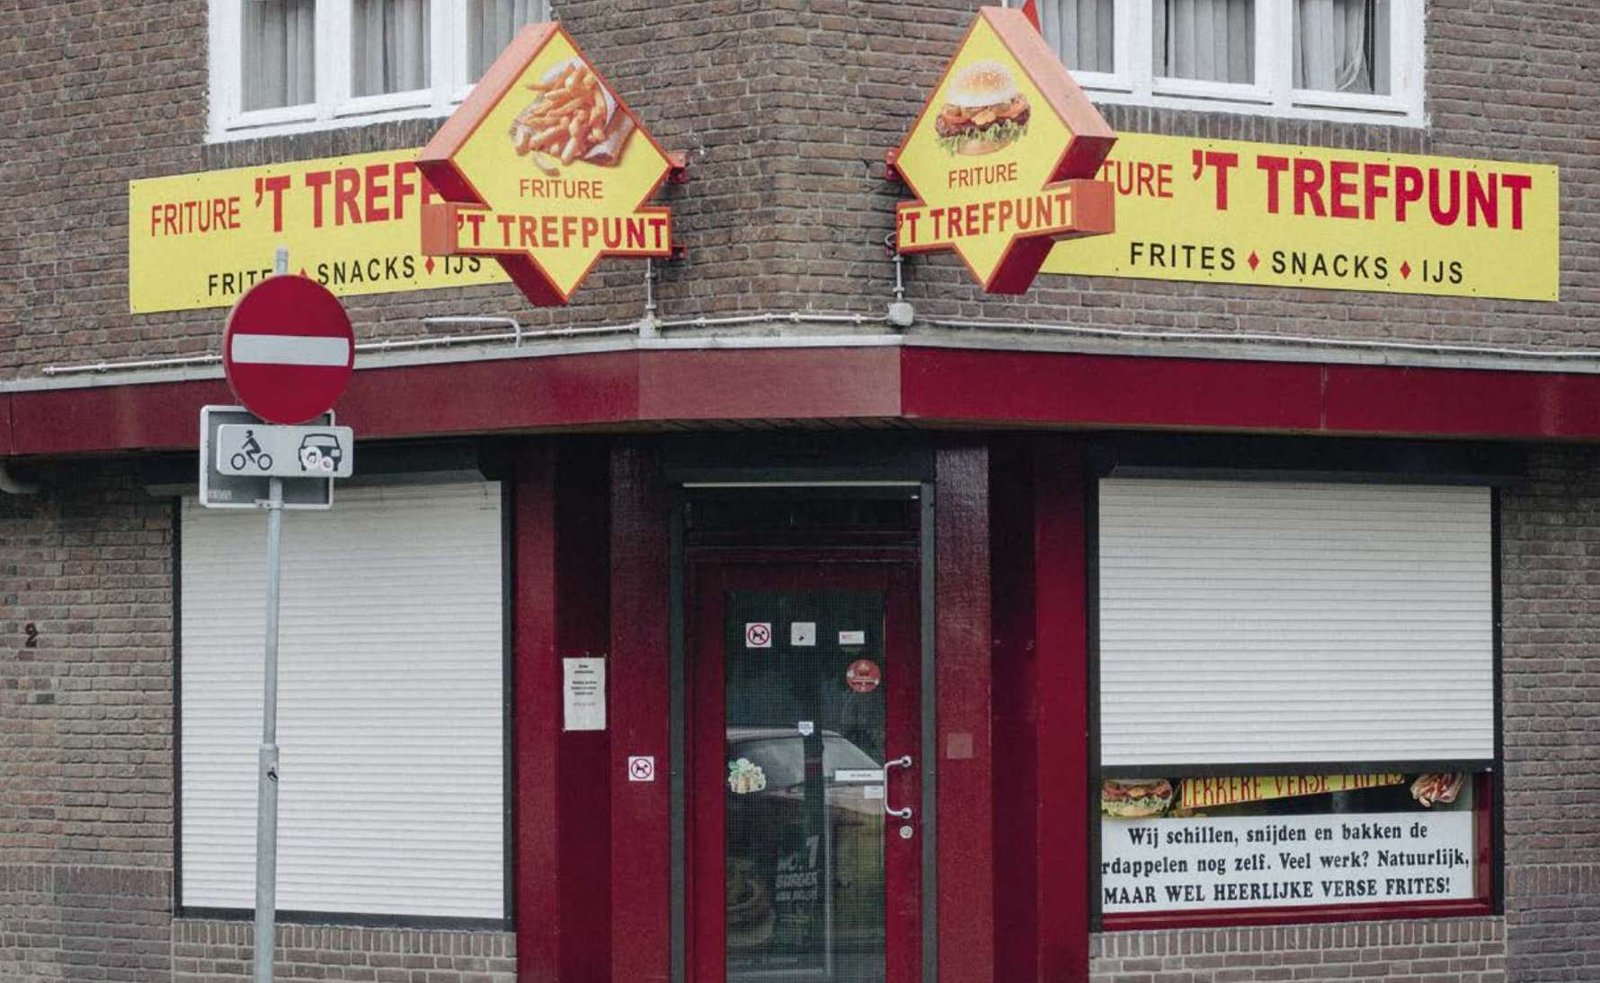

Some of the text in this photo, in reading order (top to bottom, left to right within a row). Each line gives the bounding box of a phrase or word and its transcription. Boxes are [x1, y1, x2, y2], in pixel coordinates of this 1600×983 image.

[519, 178, 604, 199] FRITURE
[948, 162, 1018, 189] FRITURE
[1103, 149, 1532, 230] TURE 'T TREFPUNT
[151, 161, 440, 237] FRITURE 'T TREF
[457, 214, 667, 248] 'T TREFPUNT
[930, 192, 1071, 240] TREFPUNT
[208, 255, 481, 297] FRIT SNACKS IJS
[1130, 242, 1463, 284] FRITES SNACKS IJS
[25, 622, 38, 648] 2
[1128, 822, 1428, 849] Wij schillen, snijden en bakken de
[1102, 848, 1469, 878] rdappelen nog zelf. Veel werk? Natuurlijk,
[1104, 877, 1450, 904] MAAR WEL HEERLIJKE VERSE FRITES!
